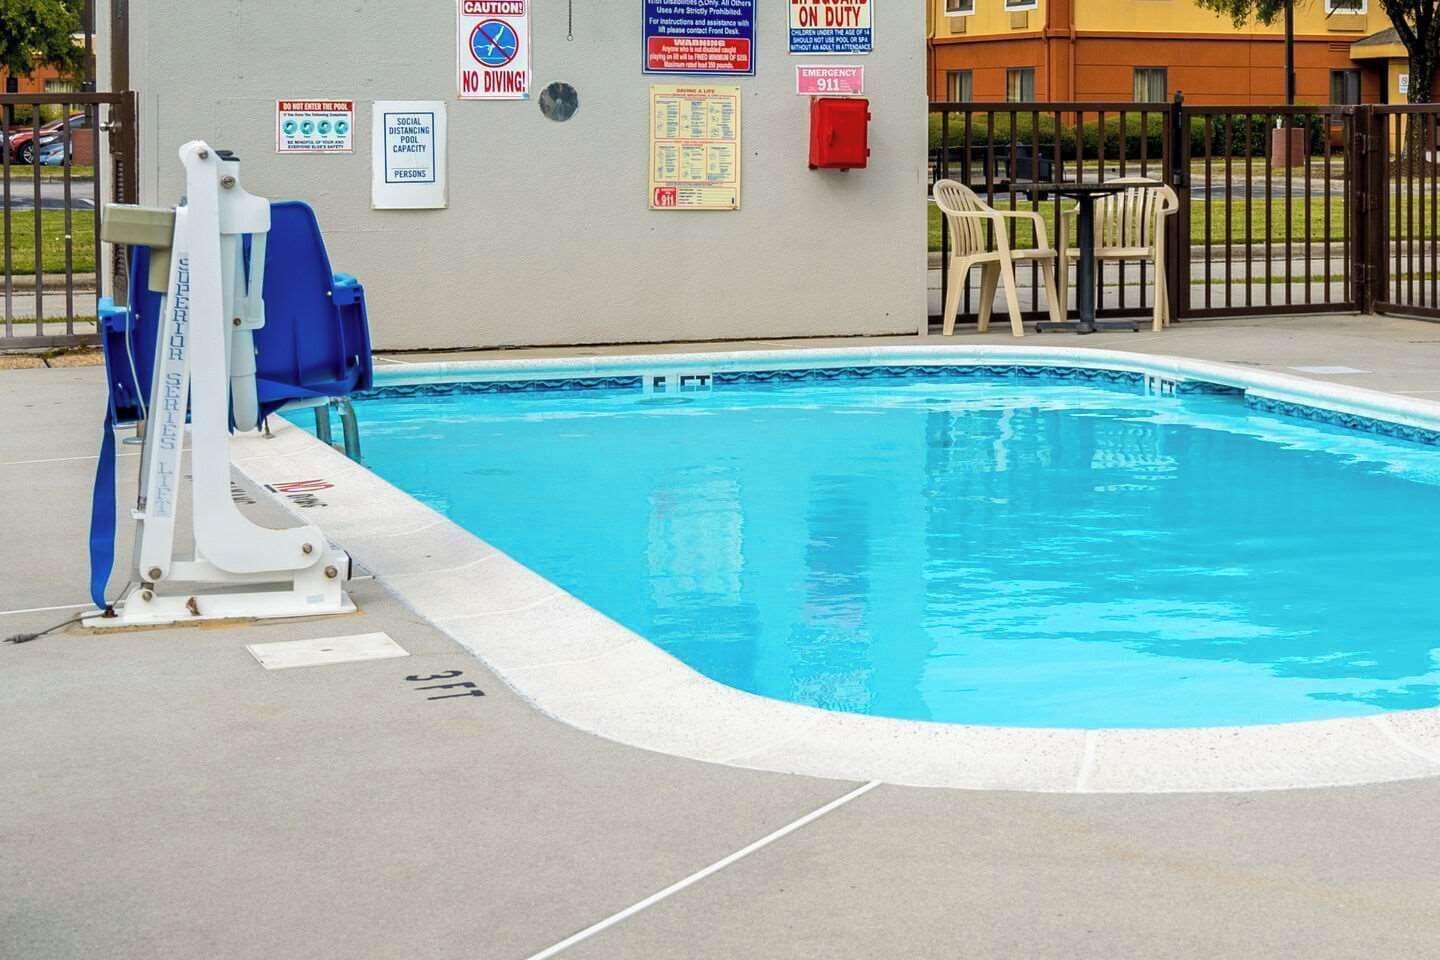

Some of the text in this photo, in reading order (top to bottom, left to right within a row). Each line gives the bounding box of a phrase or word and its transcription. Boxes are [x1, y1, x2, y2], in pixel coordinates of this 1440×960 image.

[464, 1, 523, 14] CAUTION!
[721, 0, 730, 7] All
[731, 0, 752, 8] Others
[656, 6, 672, 14] Uses
[673, 6, 684, 14] Are
[686, 7, 708, 17] Strictly
[799, 6, 861, 28] ON DUTY
[649, 17, 659, 25] For
[706, 19, 736, 27] assistance
[737, 19, 750, 27] with
[667, 26, 685, 36] please
[708, 26, 723, 34] Front
[674, 39, 726, 47] WARNING
[792, 36, 813, 44] SHOULD
[814, 36, 824, 44] NOT
[825, 36, 835, 44] USE
[802, 69, 857, 78] EMERGENCY
[463, 70, 526, 93] NO DIVING!
[817, 77, 841, 92] 911
[283, 102, 348, 111] DO NOT ENTER THE POOL
[396, 117, 421, 126] SOCIAL
[389, 126, 430, 135] DISTANCING
[400, 135, 419, 144] POOL
[393, 144, 426, 153] CAPACITY
[394, 170, 426, 178] PERSONS
[168, 258, 189, 361] SUPERIOR
[160, 372, 182, 450] SERIES
